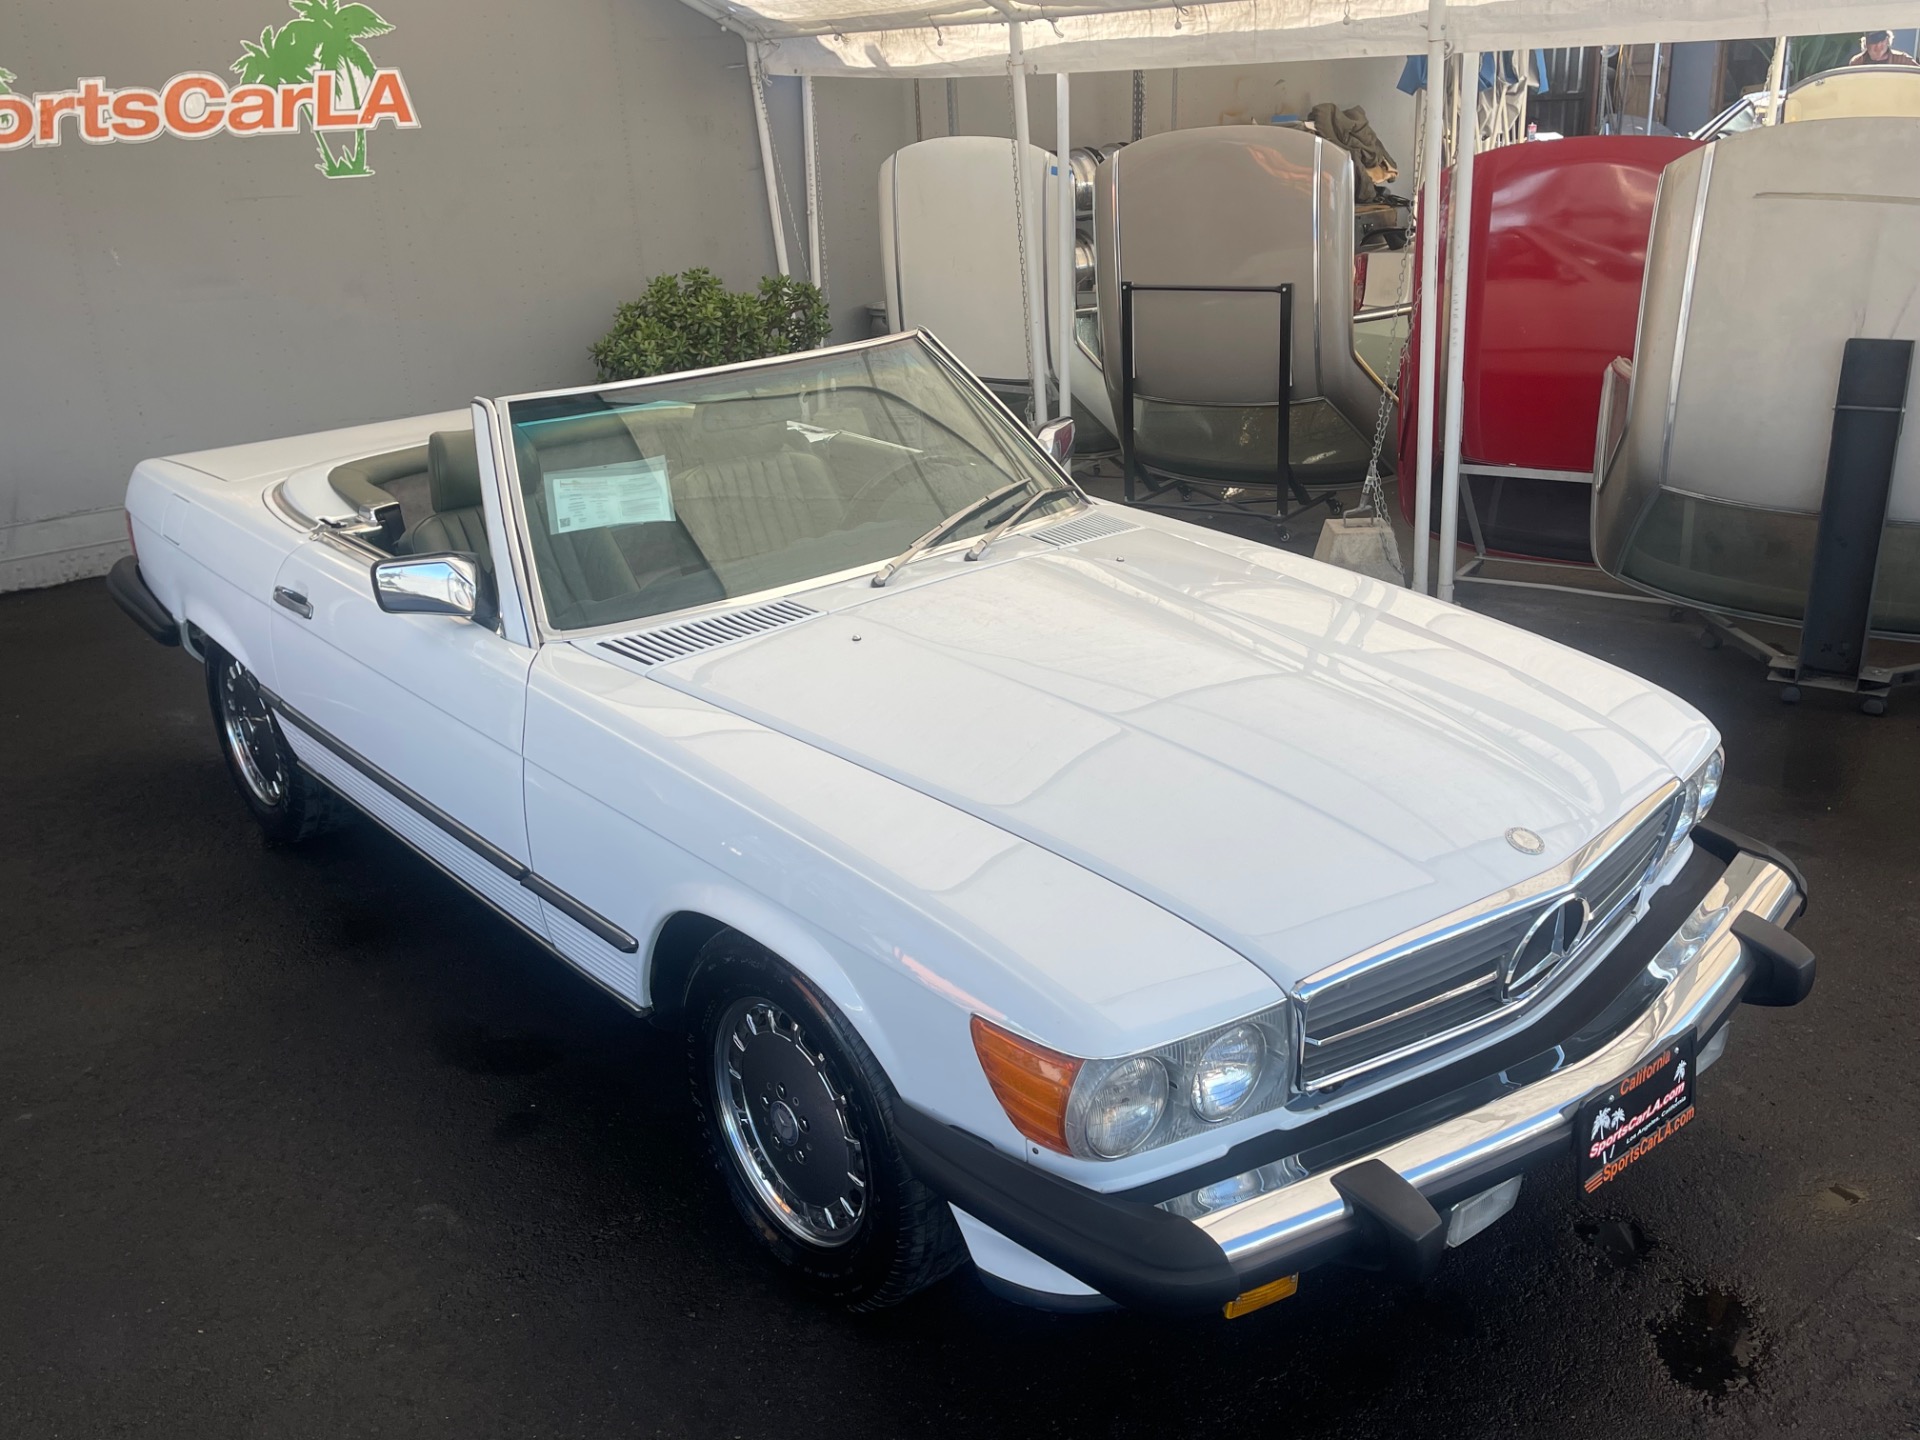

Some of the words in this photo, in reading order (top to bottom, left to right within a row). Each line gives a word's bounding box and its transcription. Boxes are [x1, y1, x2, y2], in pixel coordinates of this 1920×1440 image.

[1620, 1050, 1671, 1095] California
[1589, 1082, 1685, 1158] SportsCarLA.com
[1602, 1106, 1695, 1181] SportsCarLA.com
[1626, 1133, 1637, 1144] Los
[1661, 1096, 1687, 1117] California
